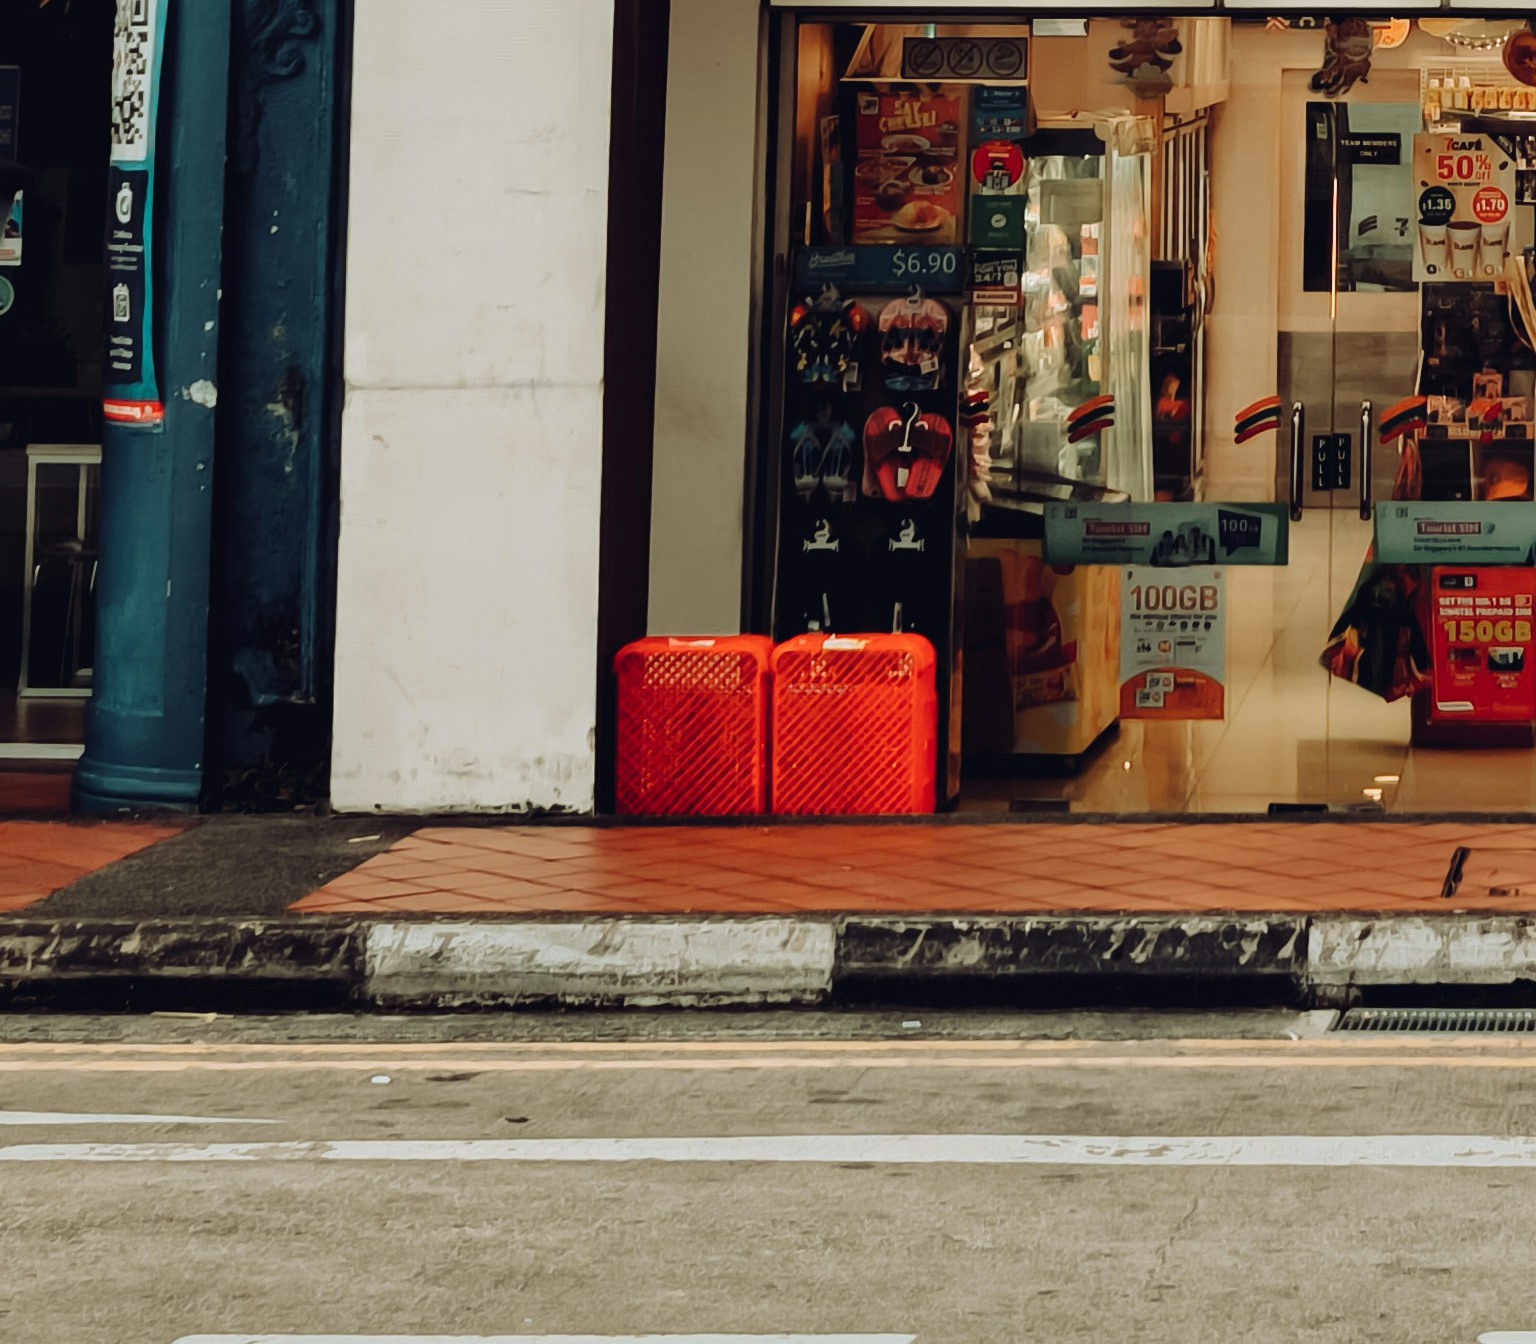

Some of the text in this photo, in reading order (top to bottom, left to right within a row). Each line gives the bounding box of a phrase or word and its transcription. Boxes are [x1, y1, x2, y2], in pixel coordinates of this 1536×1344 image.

[893, 248, 957, 278] $6.90
[1318, 439, 1326, 487] PULL
[1338, 438, 1346, 486] PULL
[1130, 585, 1218, 611] 100GB
[1444, 619, 1531, 643] 150GB
